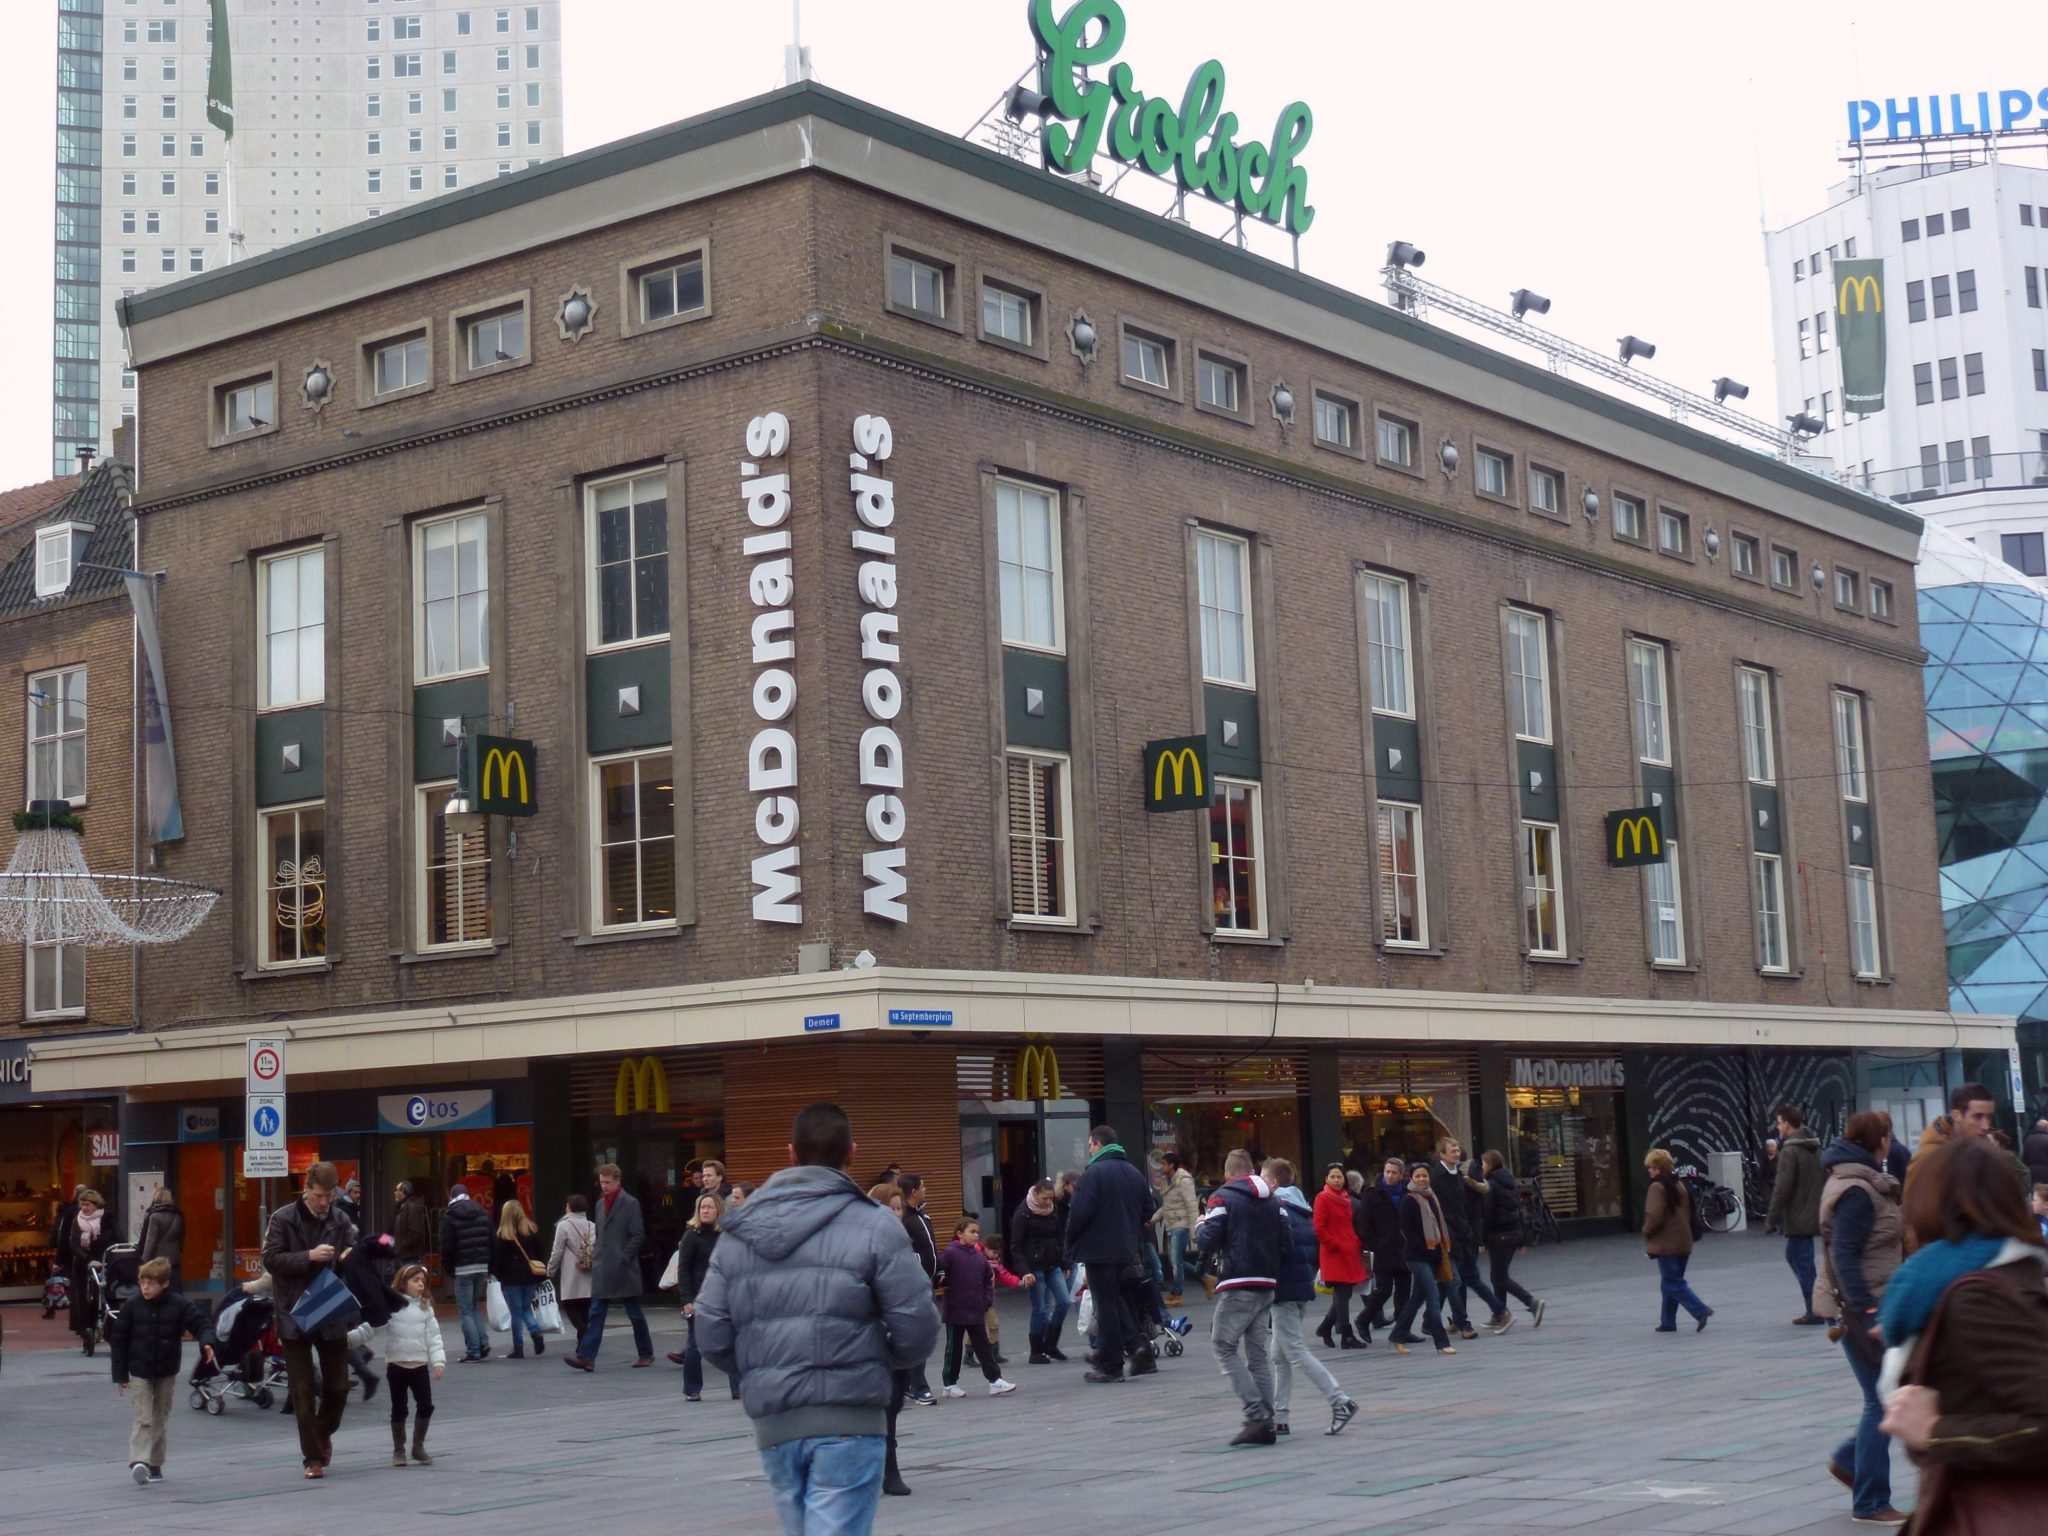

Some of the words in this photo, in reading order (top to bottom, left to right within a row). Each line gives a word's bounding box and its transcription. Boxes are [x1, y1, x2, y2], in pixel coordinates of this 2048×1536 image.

[1028, 0, 1316, 235] Grolsch
[741, 412, 803, 924] McDonald's
[850, 414, 908, 923] McDonald's
[808, 1018, 834, 1028] Demer
[900, 1011, 952, 1022] Septemberplein
[1513, 1058, 1624, 1087] McDonald's
[407, 1096, 459, 1127] etos
